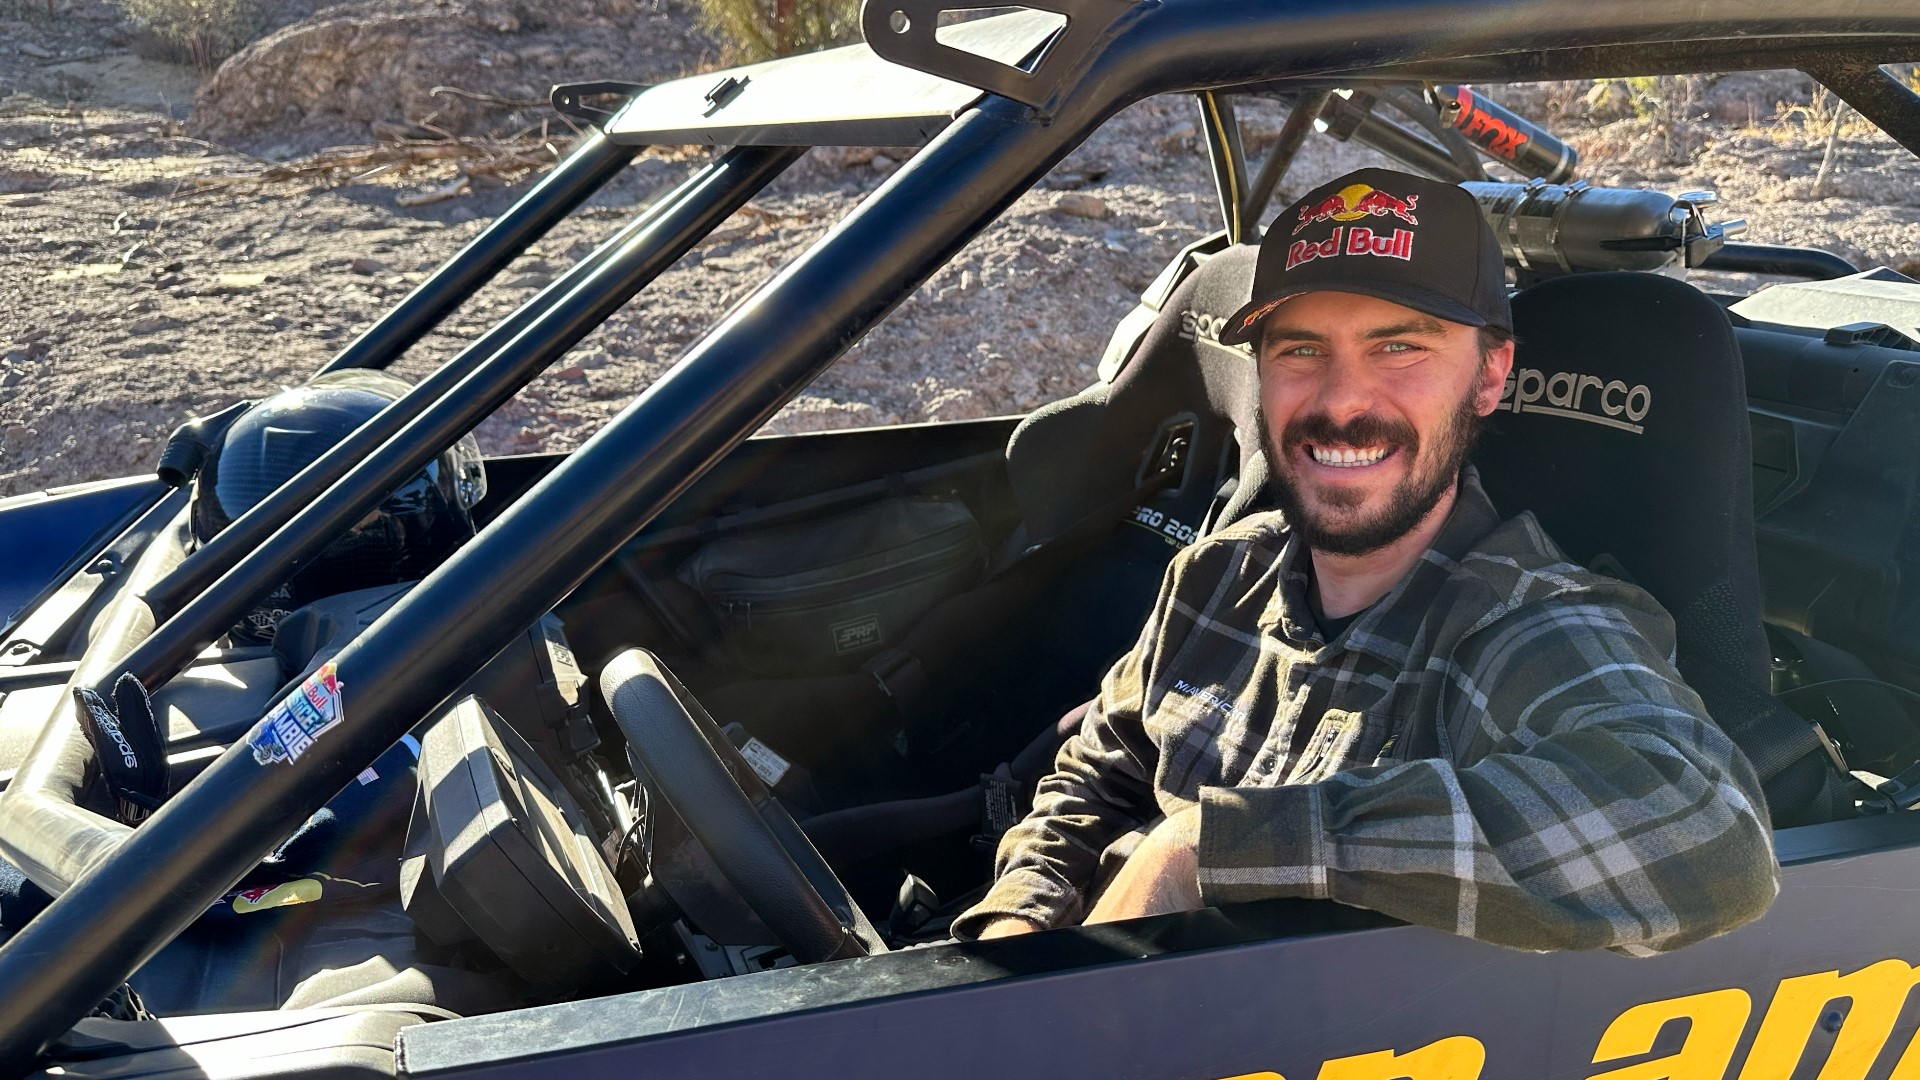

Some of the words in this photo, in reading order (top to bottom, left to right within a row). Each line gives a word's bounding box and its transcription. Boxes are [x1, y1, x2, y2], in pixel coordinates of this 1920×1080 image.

[1462, 107, 1528, 160] FOX
[1285, 226, 1344, 271] Red
[1346, 227, 1414, 261] Bull
[291, 696, 321, 732] STICE
[307, 685, 329, 709] Bull
[93, 705, 138, 769] sparco
[272, 706, 314, 763] AMBLE
